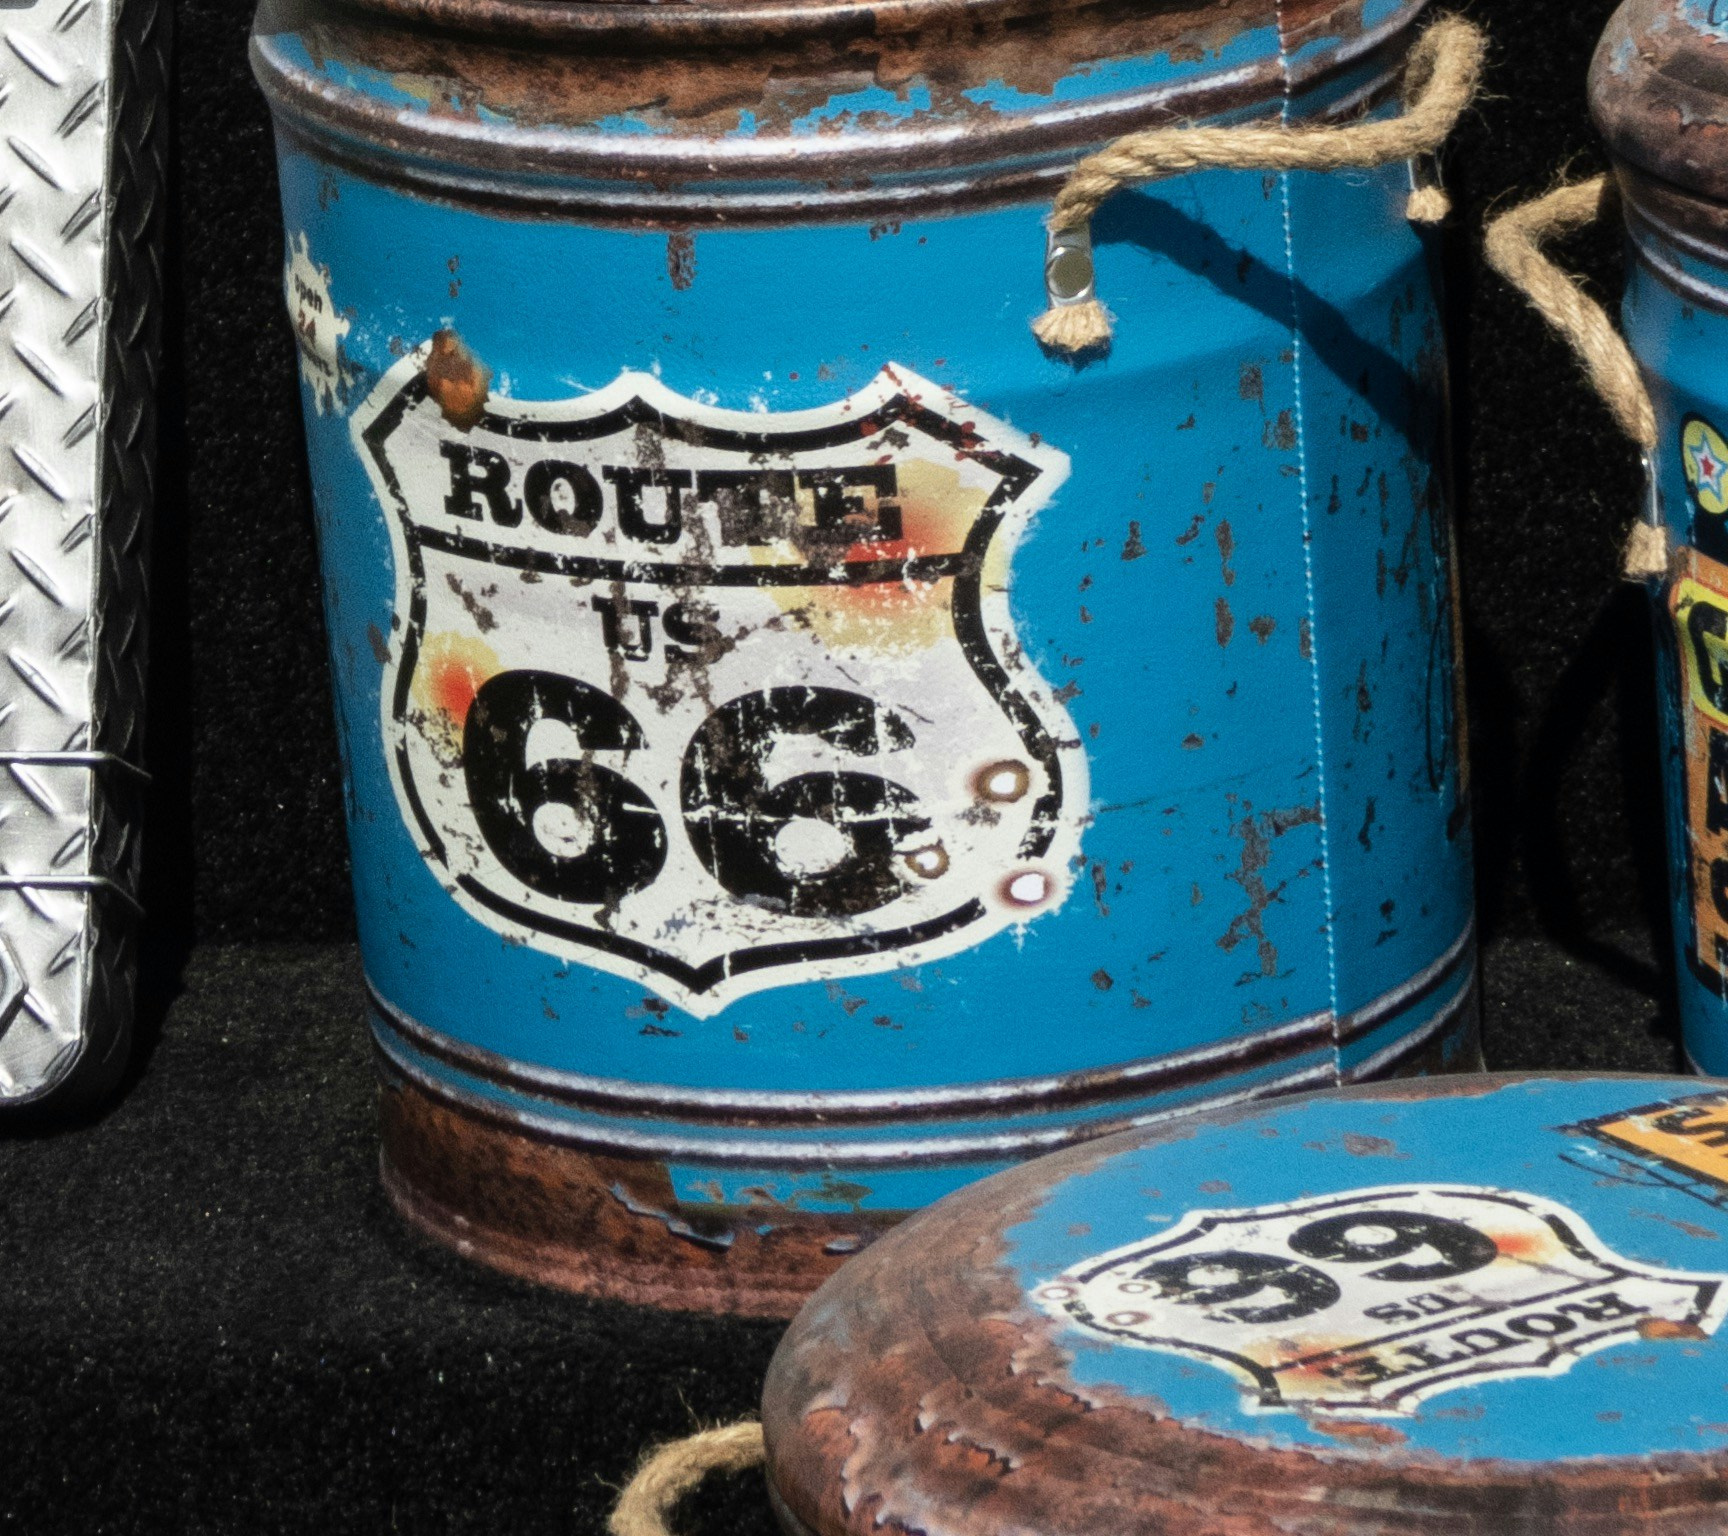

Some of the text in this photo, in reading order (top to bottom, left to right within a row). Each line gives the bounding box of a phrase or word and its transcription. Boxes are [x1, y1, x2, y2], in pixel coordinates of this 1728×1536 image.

[439, 439, 906, 563] ROUTE
[591, 596, 724, 662] US
[462, 668, 933, 920] 66
[1129, 1209, 1499, 1326] 66
[1362, 1290, 1466, 1326] US
[1314, 1291, 1650, 1389] ROUTE
